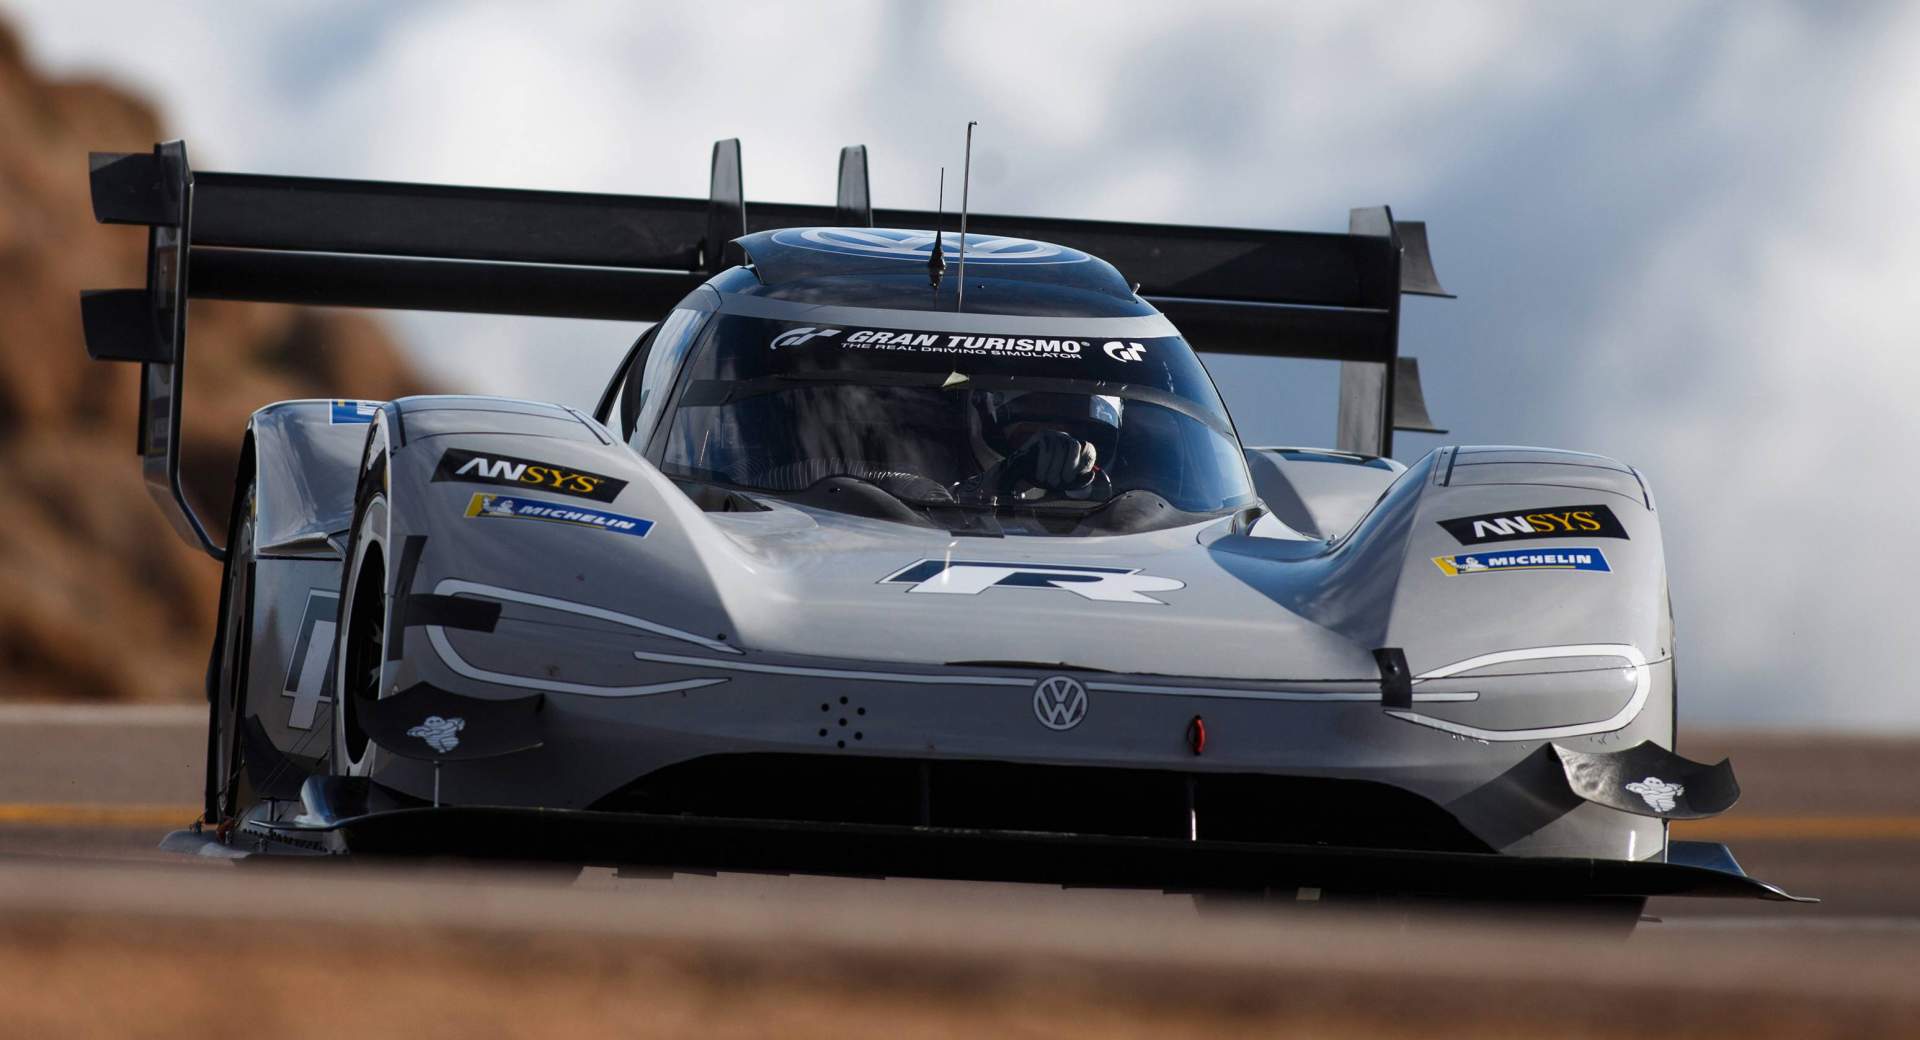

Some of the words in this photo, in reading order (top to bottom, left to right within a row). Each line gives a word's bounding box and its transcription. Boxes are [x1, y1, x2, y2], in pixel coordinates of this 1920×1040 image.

[846, 330, 940, 347] GRAN
[921, 347, 987, 355] DRIVING
[990, 350, 1082, 360] SIMULATOR
[455, 457, 603, 494] ANSYS
[518, 504, 636, 531] MICHELIN
[1473, 511, 1601, 538] ANSYS
[1488, 554, 1592, 567] MICHELIN
